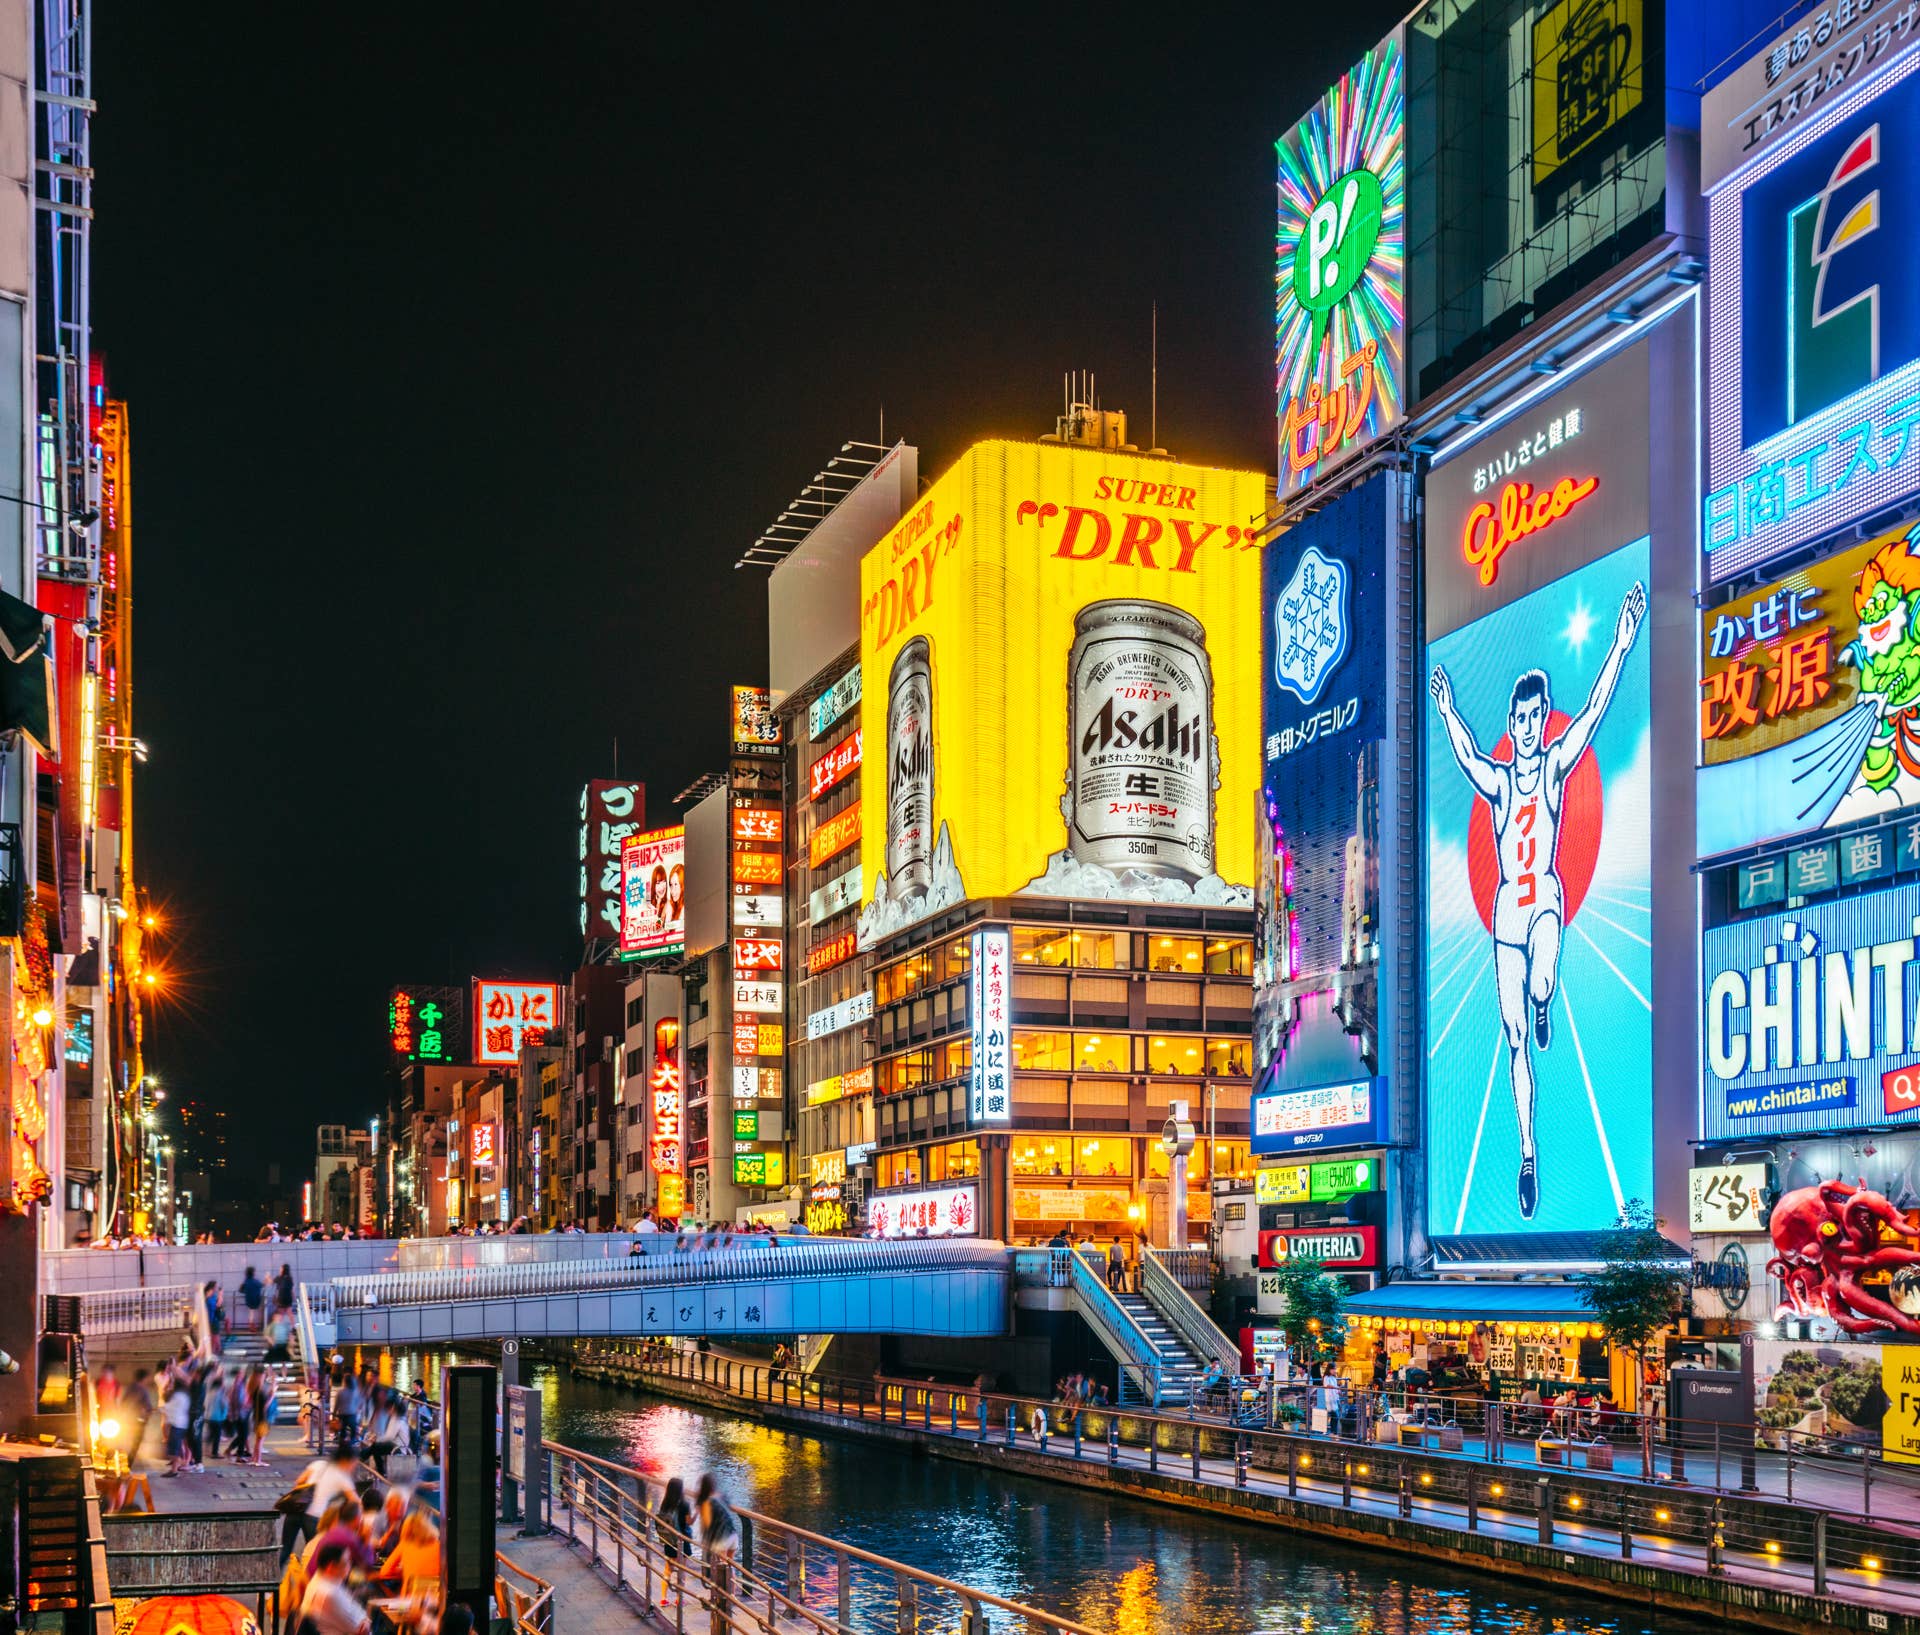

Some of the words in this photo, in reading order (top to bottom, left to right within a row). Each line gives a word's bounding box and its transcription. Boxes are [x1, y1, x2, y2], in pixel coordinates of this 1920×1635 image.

[1288, 338, 1379, 473] ピップ
[1473, 408, 1582, 494] おいしさと健康
[1094, 475, 1198, 511] SUPER
[891, 500, 934, 564] SUPER
[1463, 476, 1601, 586] Glico
[1710, 587, 1818, 658] かぜに
[1095, 661, 1116, 684] ASAHI
[1117, 653, 1161, 668] BREWERIES
[1163, 662, 1188, 692] LIMITED
[1700, 626, 1832, 740] 改源
[1082, 696, 1200, 763] Asahi
[1267, 697, 1357, 760] 雪印メグミルク
[1125, 773, 1160, 798] 生
[736, 799, 752, 808] 8F
[1109, 803, 1178, 819] スーパードライ
[1128, 816, 1158, 828] 生ビール
[736, 842, 752, 851] 7F
[1128, 841, 1158, 855] 350ml
[1515, 795, 1538, 907] グリコ
[736, 885, 752, 894] 6F
[744, 928, 757, 938] 5F
[735, 971, 752, 980] 4F
[737, 986, 778, 1003] 白木屋
[989, 961, 1003, 1023] 本場の味
[486, 991, 548, 1022] かに
[1708, 930, 1920, 1080] CHINT
[393, 992, 411, 1052] お好み焼
[419, 1002, 443, 1053] 千房
[735, 1014, 752, 1023] 3F
[735, 1057, 752, 1066] 2F
[736, 1100, 752, 1109] 1F
[1290, 1236, 1356, 1258] LOTTERIA
[646, 1305, 761, 1323] えびす橋
[1491, 1352, 1515, 1368] お好み
[1699, 1385, 1733, 1395] information
